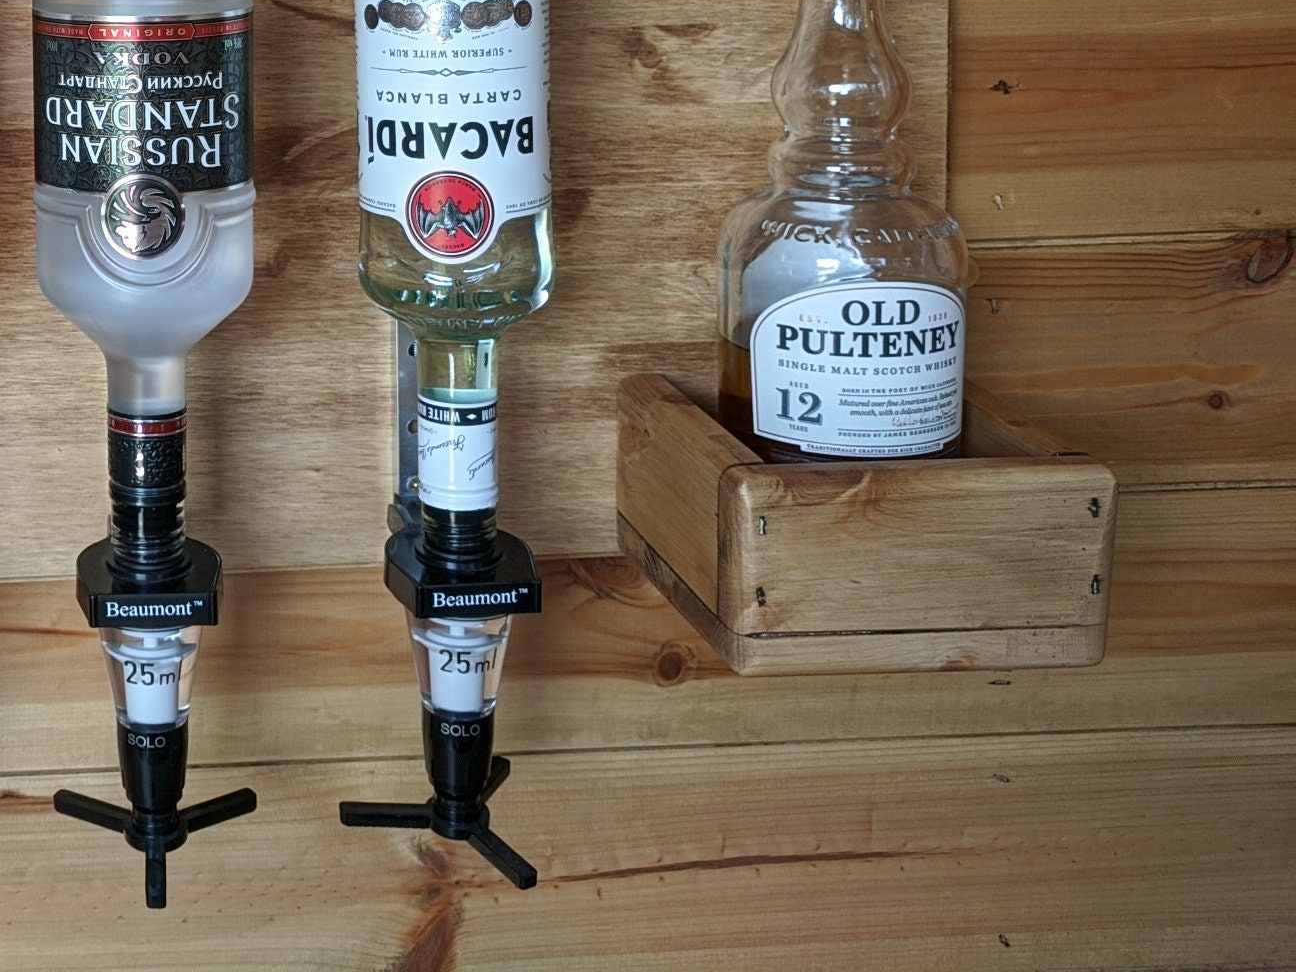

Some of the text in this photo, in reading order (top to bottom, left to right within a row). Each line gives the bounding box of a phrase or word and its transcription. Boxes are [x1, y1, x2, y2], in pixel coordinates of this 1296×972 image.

[97, 28, 186, 40] ORIGINAL
[91, 51, 190, 66] VODKA
[389, 47, 504, 58] SUPERIOR WHITE RUM
[375, 89, 522, 105] CARTA BLANCA
[44, 92, 240, 131] STANDARD
[60, 132, 222, 168] RUSSIAN
[841, 299, 920, 326] OLD
[776, 320, 960, 357] PULTENEY
[778, 357, 957, 376] SINGLE MALT SCOTCH WHISKY
[789, 381, 809, 389] AGED
[775, 387, 824, 426] 12
[838, 399, 870, 407] Matured
[898, 398, 927, 406] American
[428, 408, 461, 423] WHITE
[789, 424, 808, 433] YEARS
[807, 444, 856, 453] TRADITIONALLY
[440, 722, 480, 738] SOLO
[127, 733, 166, 748] SOLO
